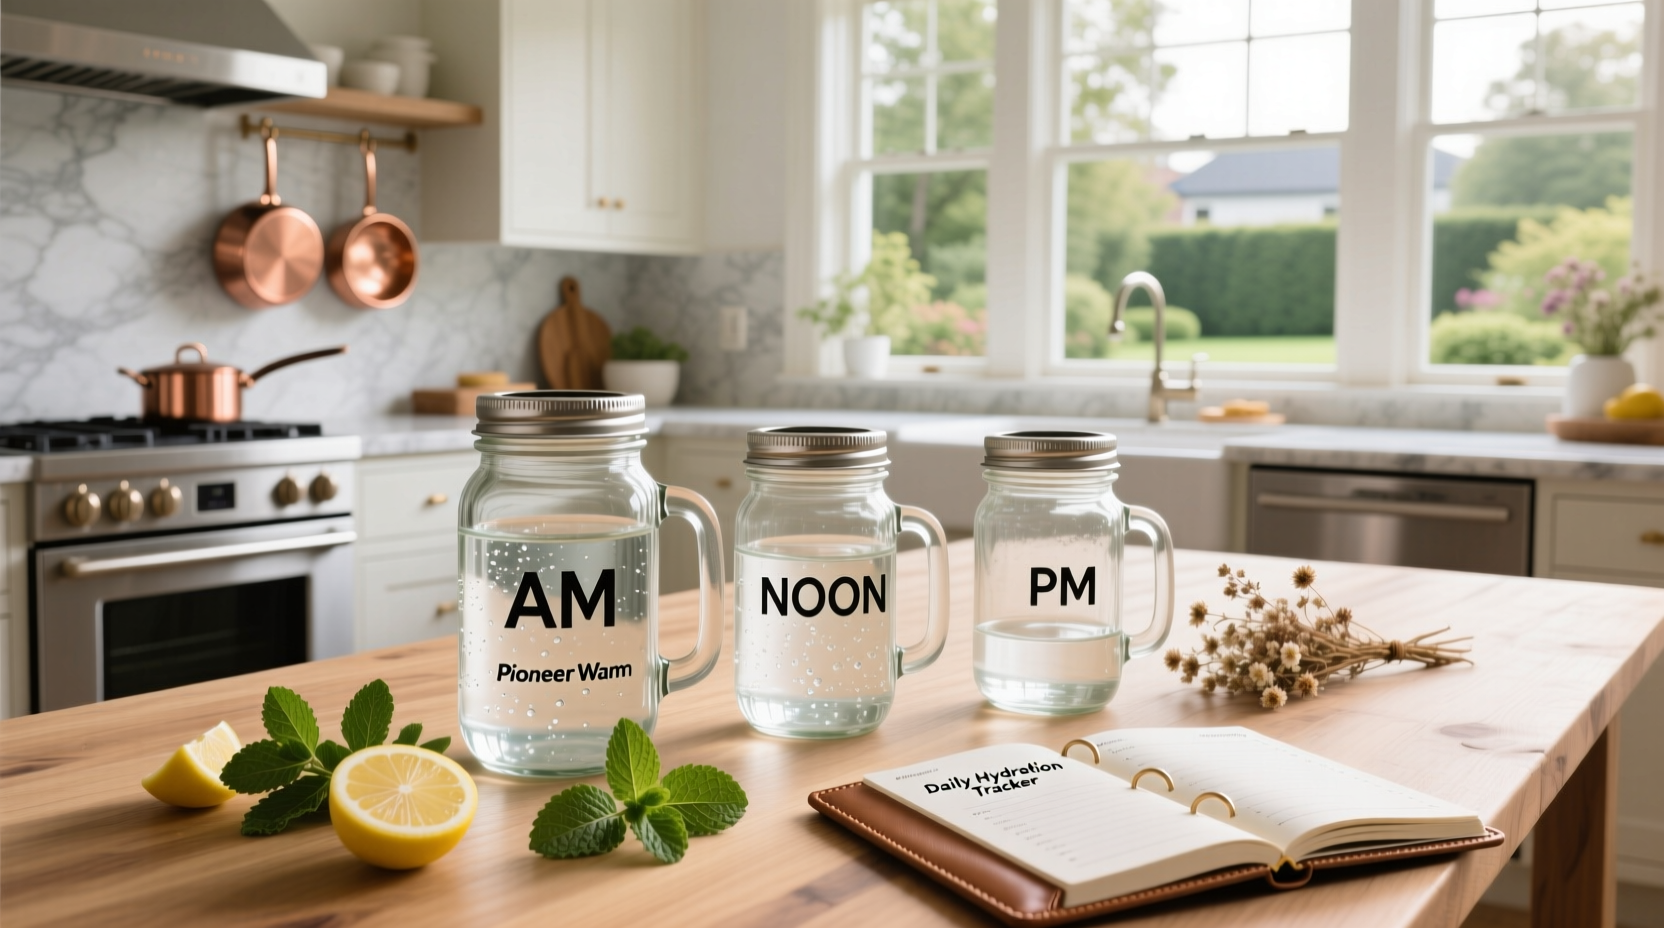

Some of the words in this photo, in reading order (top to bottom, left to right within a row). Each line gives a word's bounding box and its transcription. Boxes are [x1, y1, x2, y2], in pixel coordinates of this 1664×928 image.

[505, 569, 616, 629] AM
[760, 573, 887, 618] NOON
[1030, 567, 1096, 606] PM
[496, 662, 575, 683] Pioneer
[924, 776, 971, 794] Daily
[971, 776, 1039, 797] Tracker
